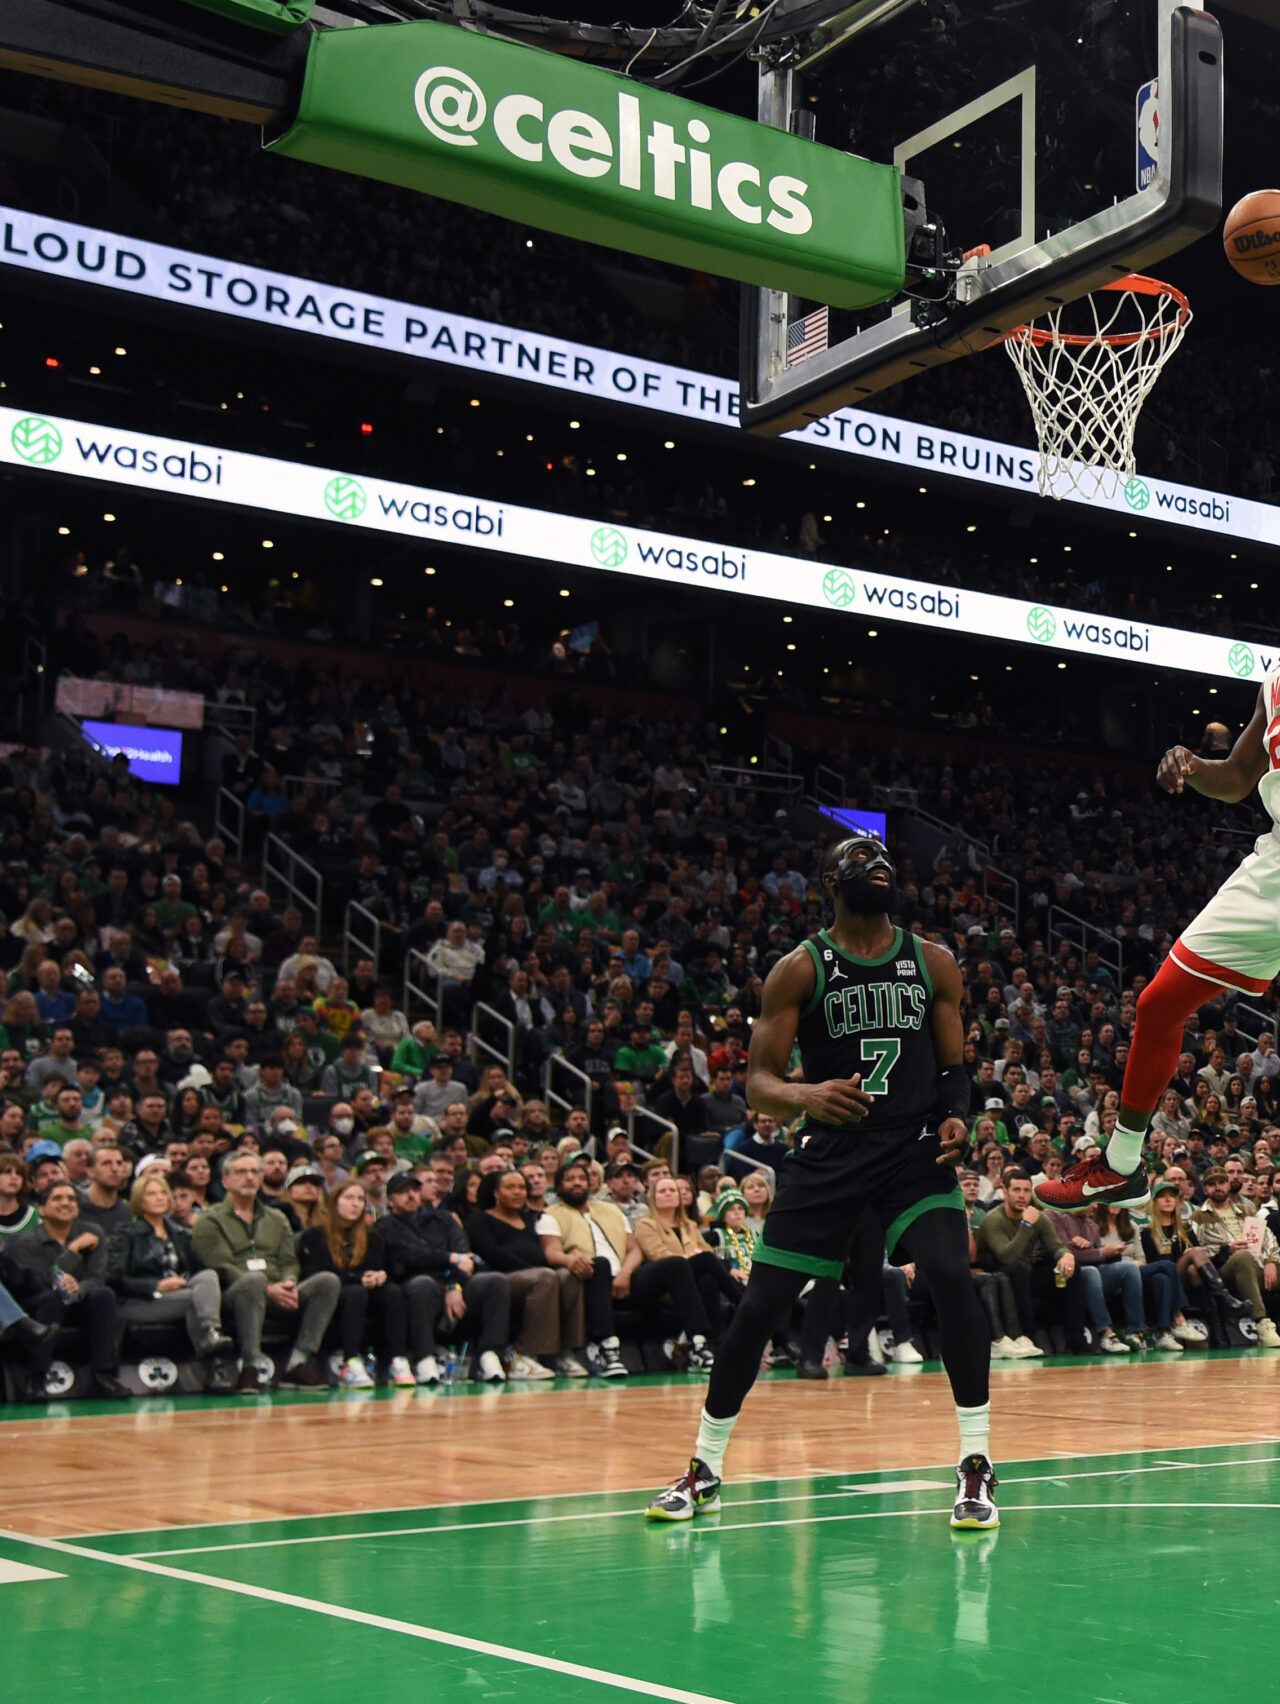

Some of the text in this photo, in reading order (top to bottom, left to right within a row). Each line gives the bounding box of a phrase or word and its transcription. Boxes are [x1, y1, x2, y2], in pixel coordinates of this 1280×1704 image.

[413, 66, 814, 236] @celtics
[168, 263, 385, 338] STORAGE
[404, 317, 595, 385] PARTNER
[611, 367, 661, 398] OF
[675, 380, 740, 417] THE
[812, 415, 901, 454] STON
[916, 435, 1034, 483] BRUINS
[75, 437, 222, 485] wasabi
[378, 493, 503, 537] wasabi
[1155, 491, 1230, 522] wasabi
[637, 542, 746, 580] wasabi
[863, 580, 960, 619] wasabi
[1063, 618, 1149, 652] wasabi
[823, 949, 834, 962] 6
[896, 960, 917, 969] VISTA
[896, 969, 917, 977] PRINT
[824, 981, 926, 1039] CELTICS
[860, 1038, 901, 1095] 7
